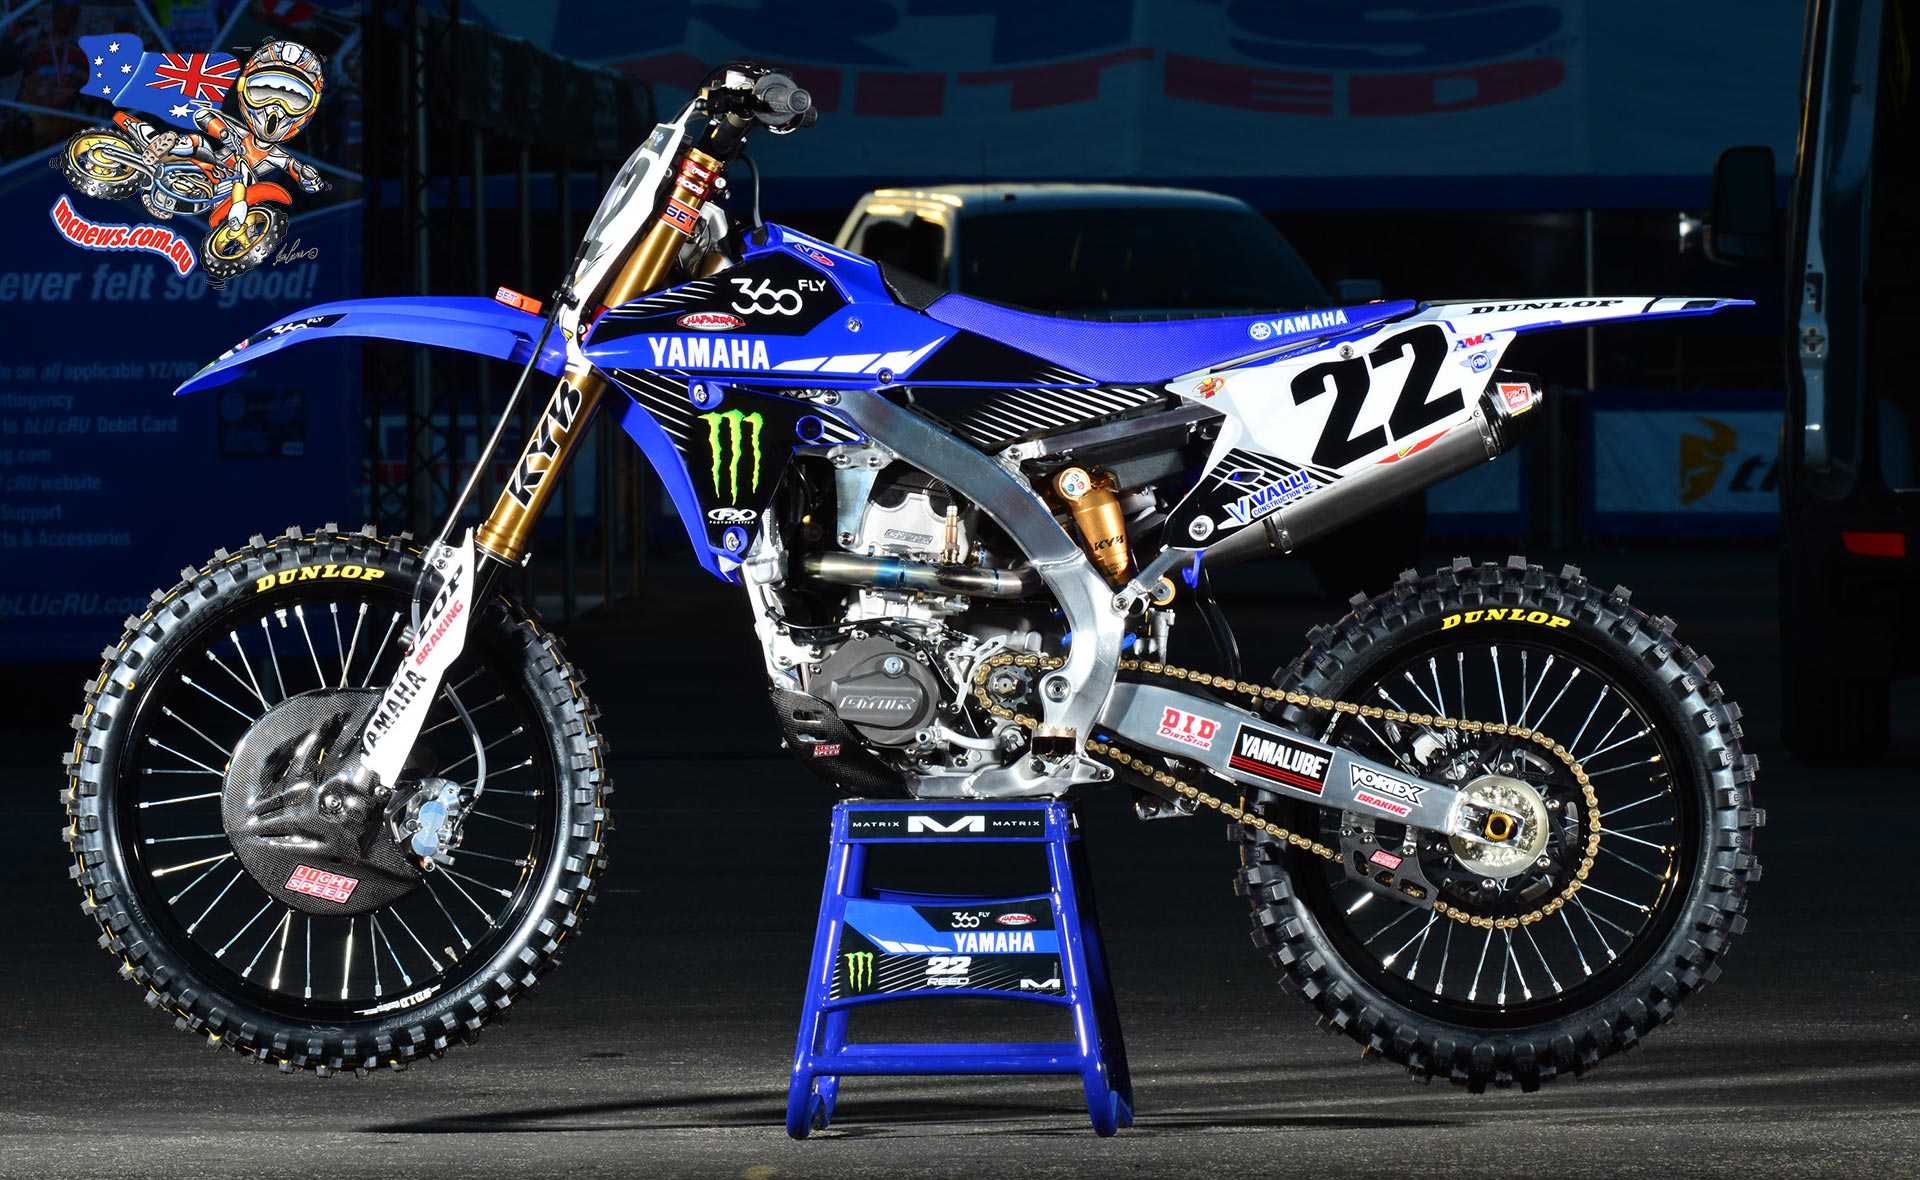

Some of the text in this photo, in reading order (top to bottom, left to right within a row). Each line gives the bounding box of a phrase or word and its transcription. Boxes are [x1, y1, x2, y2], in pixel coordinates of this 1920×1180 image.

[91, 263, 155, 300] felt
[163, 271, 208, 301] so
[216, 263, 320, 309] good!
[731, 278, 827, 316] 360 FLY
[1467, 299, 1624, 316] DUNLOP
[306, 316, 325, 325] FLY
[1270, 309, 1349, 336] YAMAHA
[648, 336, 771, 370] YAMAHA
[1453, 332, 1495, 352] AMA
[16, 366, 36, 380] on
[64, 361, 145, 383] applicable
[1290, 324, 1466, 470] 22
[3, 418, 18, 434] to
[97, 416, 139, 434] Debit
[142, 416, 178, 434] Card
[507, 378, 583, 510] KYB
[41, 473, 102, 491] website
[1252, 470, 1310, 505] VALLI
[1253, 482, 1316, 517] CONSTRUCTION INC.
[1, 503, 62, 524] Support
[38, 530, 131, 547] Accessories
[256, 564, 385, 593] DUNLOP
[1440, 607, 1571, 630] DUNLOP
[415, 600, 464, 666] BRAKING
[360, 669, 427, 757] YAMAHA
[1241, 733, 1327, 779] YAMALUBE
[1350, 763, 1429, 805] VORTEX
[1356, 793, 1410, 816] BRAKING
[286, 878, 350, 903] SPEED
[293, 865, 358, 891] LIGHT
[951, 911, 981, 928] 360
[954, 931, 1036, 953] YAMAHA
[925, 956, 972, 975] 22
[926, 977, 970, 987] REED
